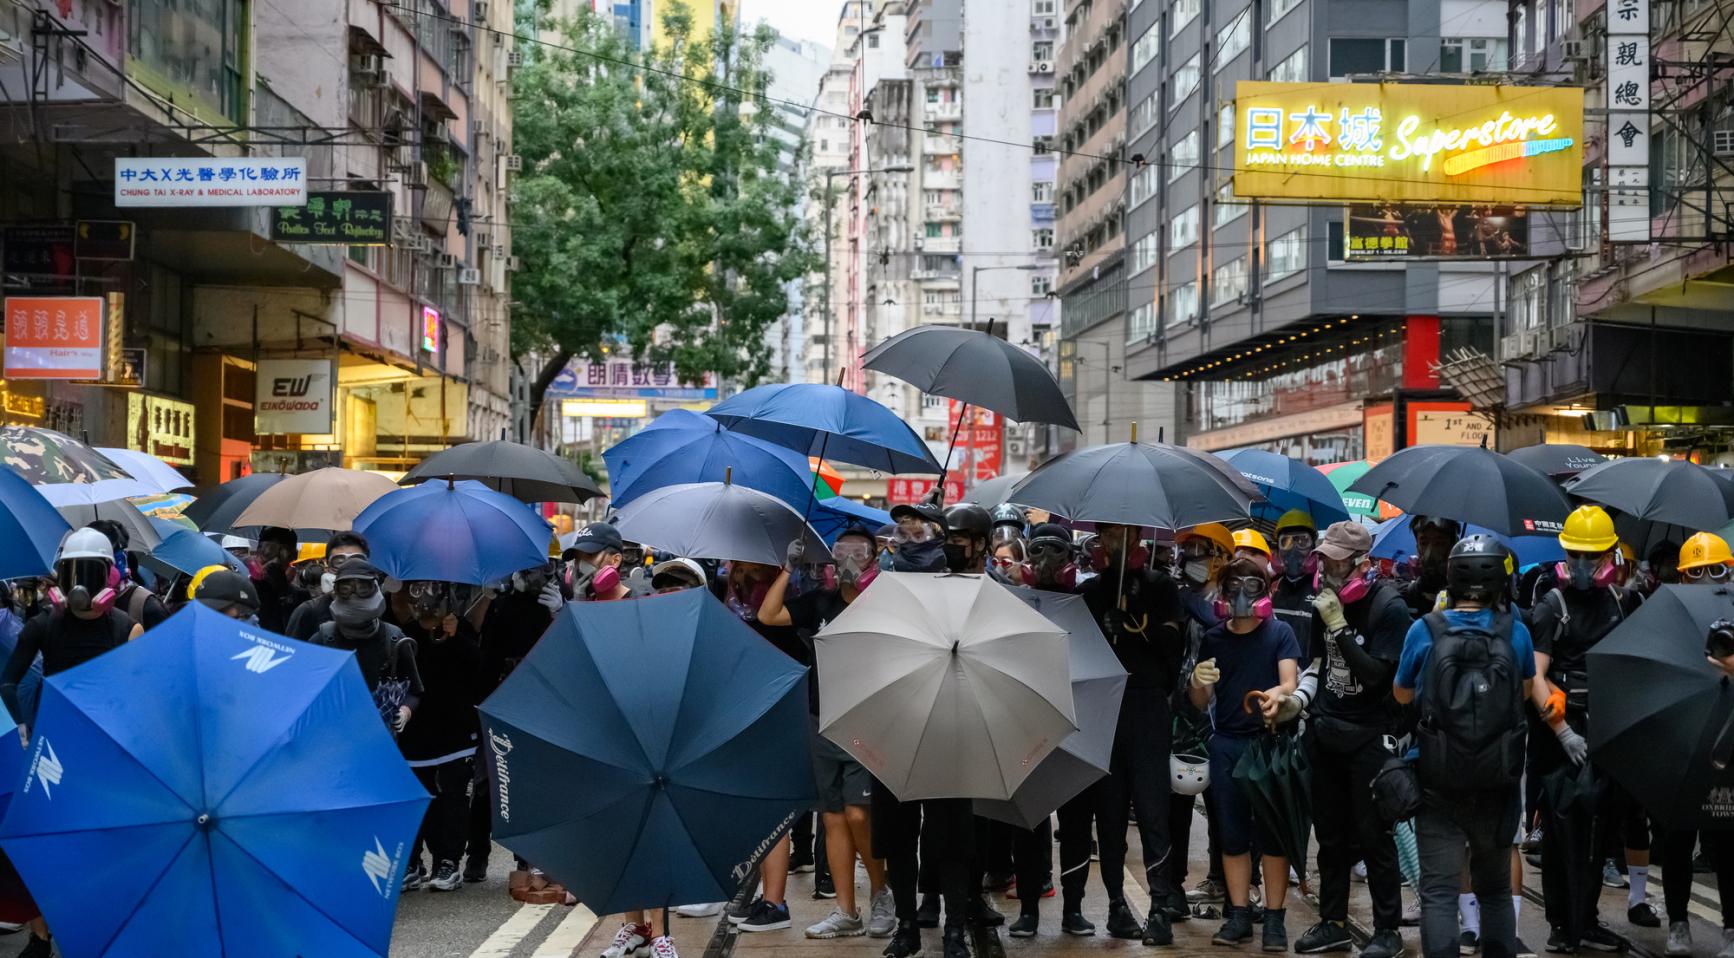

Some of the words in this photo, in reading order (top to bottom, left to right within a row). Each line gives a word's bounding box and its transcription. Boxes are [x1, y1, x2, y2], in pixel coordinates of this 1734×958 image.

[1245, 105, 1384, 151] 日本城
[1389, 110, 1558, 171] Superstore
[1246, 153, 1287, 166] JAPAN
[1290, 153, 1331, 167] HOME
[1334, 153, 1385, 167] CENTRE
[119, 167, 302, 183] 中大X光醫學化驗所
[119, 188, 150, 197] CHUNG
[153, 188, 167, 197] TAI
[170, 188, 194, 197] X-RAY
[197, 188, 204, 197] &
[207, 188, 244, 197] MEDICAL
[246, 188, 301, 197] LABORATORY
[313, 222, 336, 236] Foot
[272, 374, 312, 397] EW
[1444, 418, 1463, 430] 1st
[1466, 423, 1482, 431] AND
[1461, 432, 1485, 440] FLOO
[239, 630, 256, 642] BOX
[256, 637, 296, 654] NETWORK
[30, 735, 45, 776] NETWORK
[23, 776, 33, 794] BOX
[384, 860, 400, 899] NETWORK
[395, 842, 404, 859] BOX
